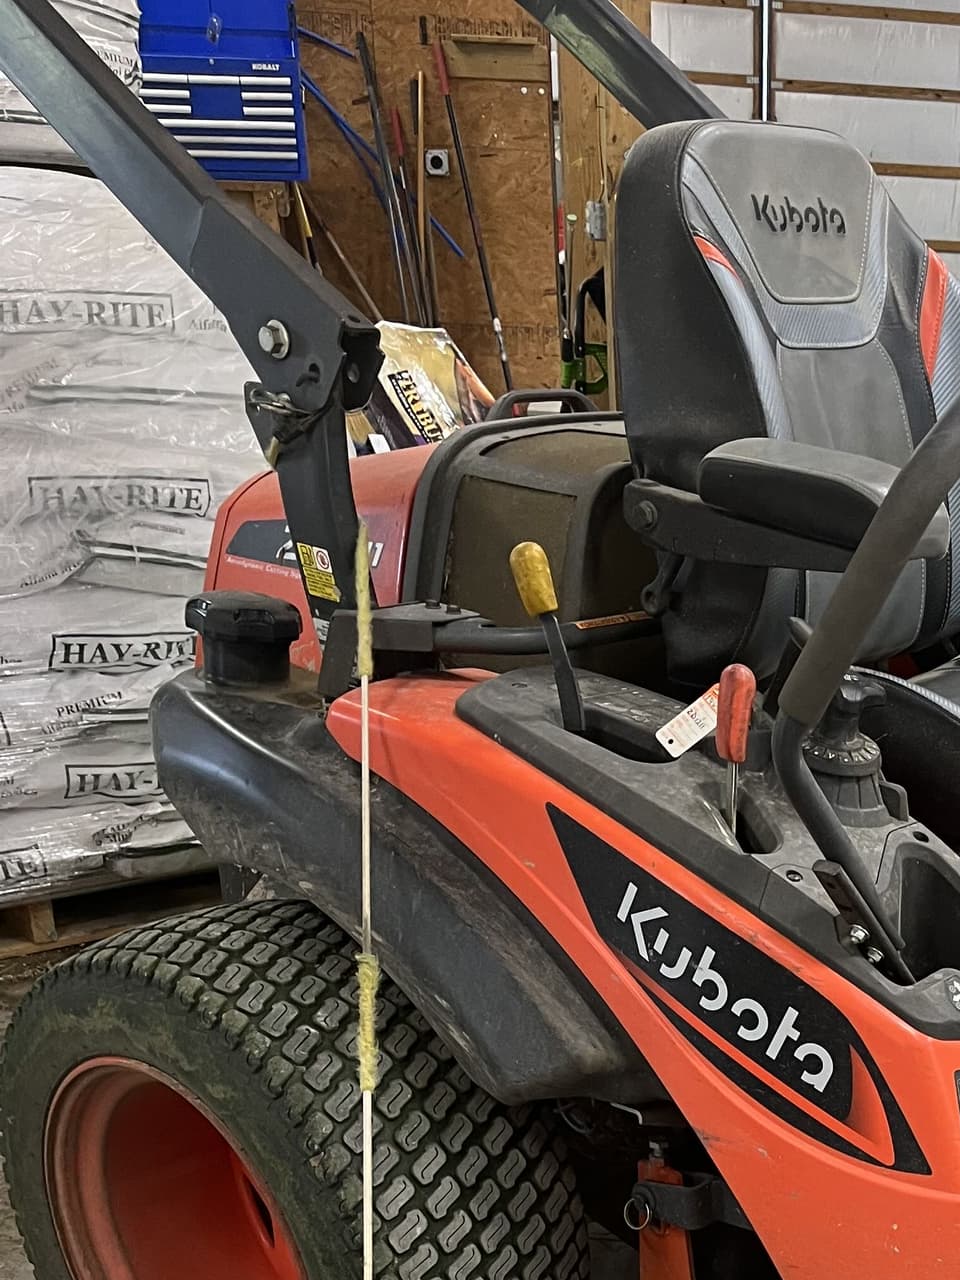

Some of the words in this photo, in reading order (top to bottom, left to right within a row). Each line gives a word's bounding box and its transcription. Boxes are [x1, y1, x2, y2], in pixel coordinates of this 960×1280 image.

[251, 63, 280, 72] KOBALT
[750, 192, 847, 235] Kubota
[40, 483, 204, 512] HAY-RITE
[56, 691, 123, 718] PREMIUM
[615, 881, 835, 1094] Kubota
